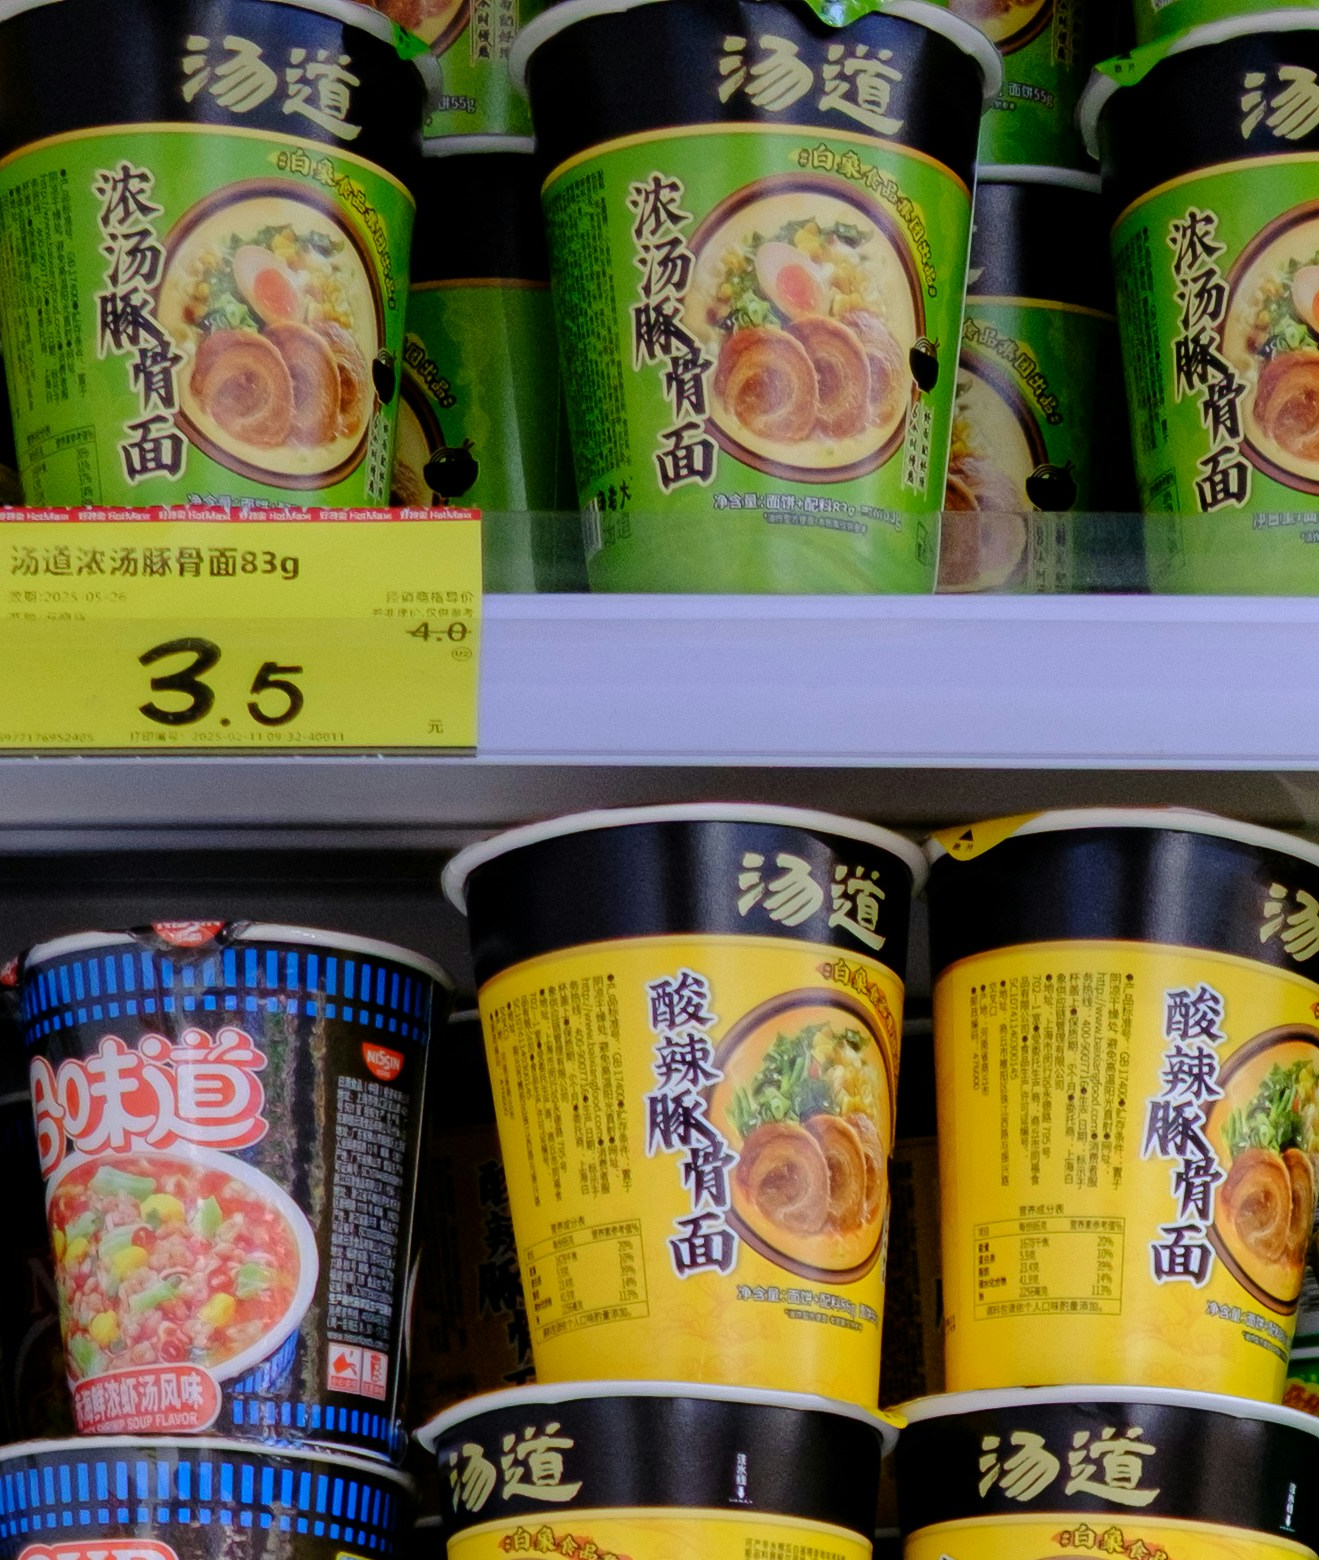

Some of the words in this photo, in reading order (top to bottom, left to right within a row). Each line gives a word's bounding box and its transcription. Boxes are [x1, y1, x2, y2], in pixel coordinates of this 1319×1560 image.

[181, 35, 363, 142] 汤道
[718, 35, 906, 136] 汤道
[89, 163, 186, 485] 浓汤豚骨面
[629, 173, 716, 491] 浓汤豚骨面
[1167, 208, 1252, 513] 浓汤豚骨面
[10, 545, 300, 580] 汤道浓汤豚骨面83g
[137, 636, 305, 727] 3.5
[405, 621, 470, 643] 4.0
[737, 851, 890, 951] 汤道
[645, 969, 739, 1282] 酸辣豚骨面
[1140, 985, 1227, 1289] 酸辣豚骨面
[449, 1423, 584, 1512] 汤道
[976, 1428, 1161, 1512] 汤道
